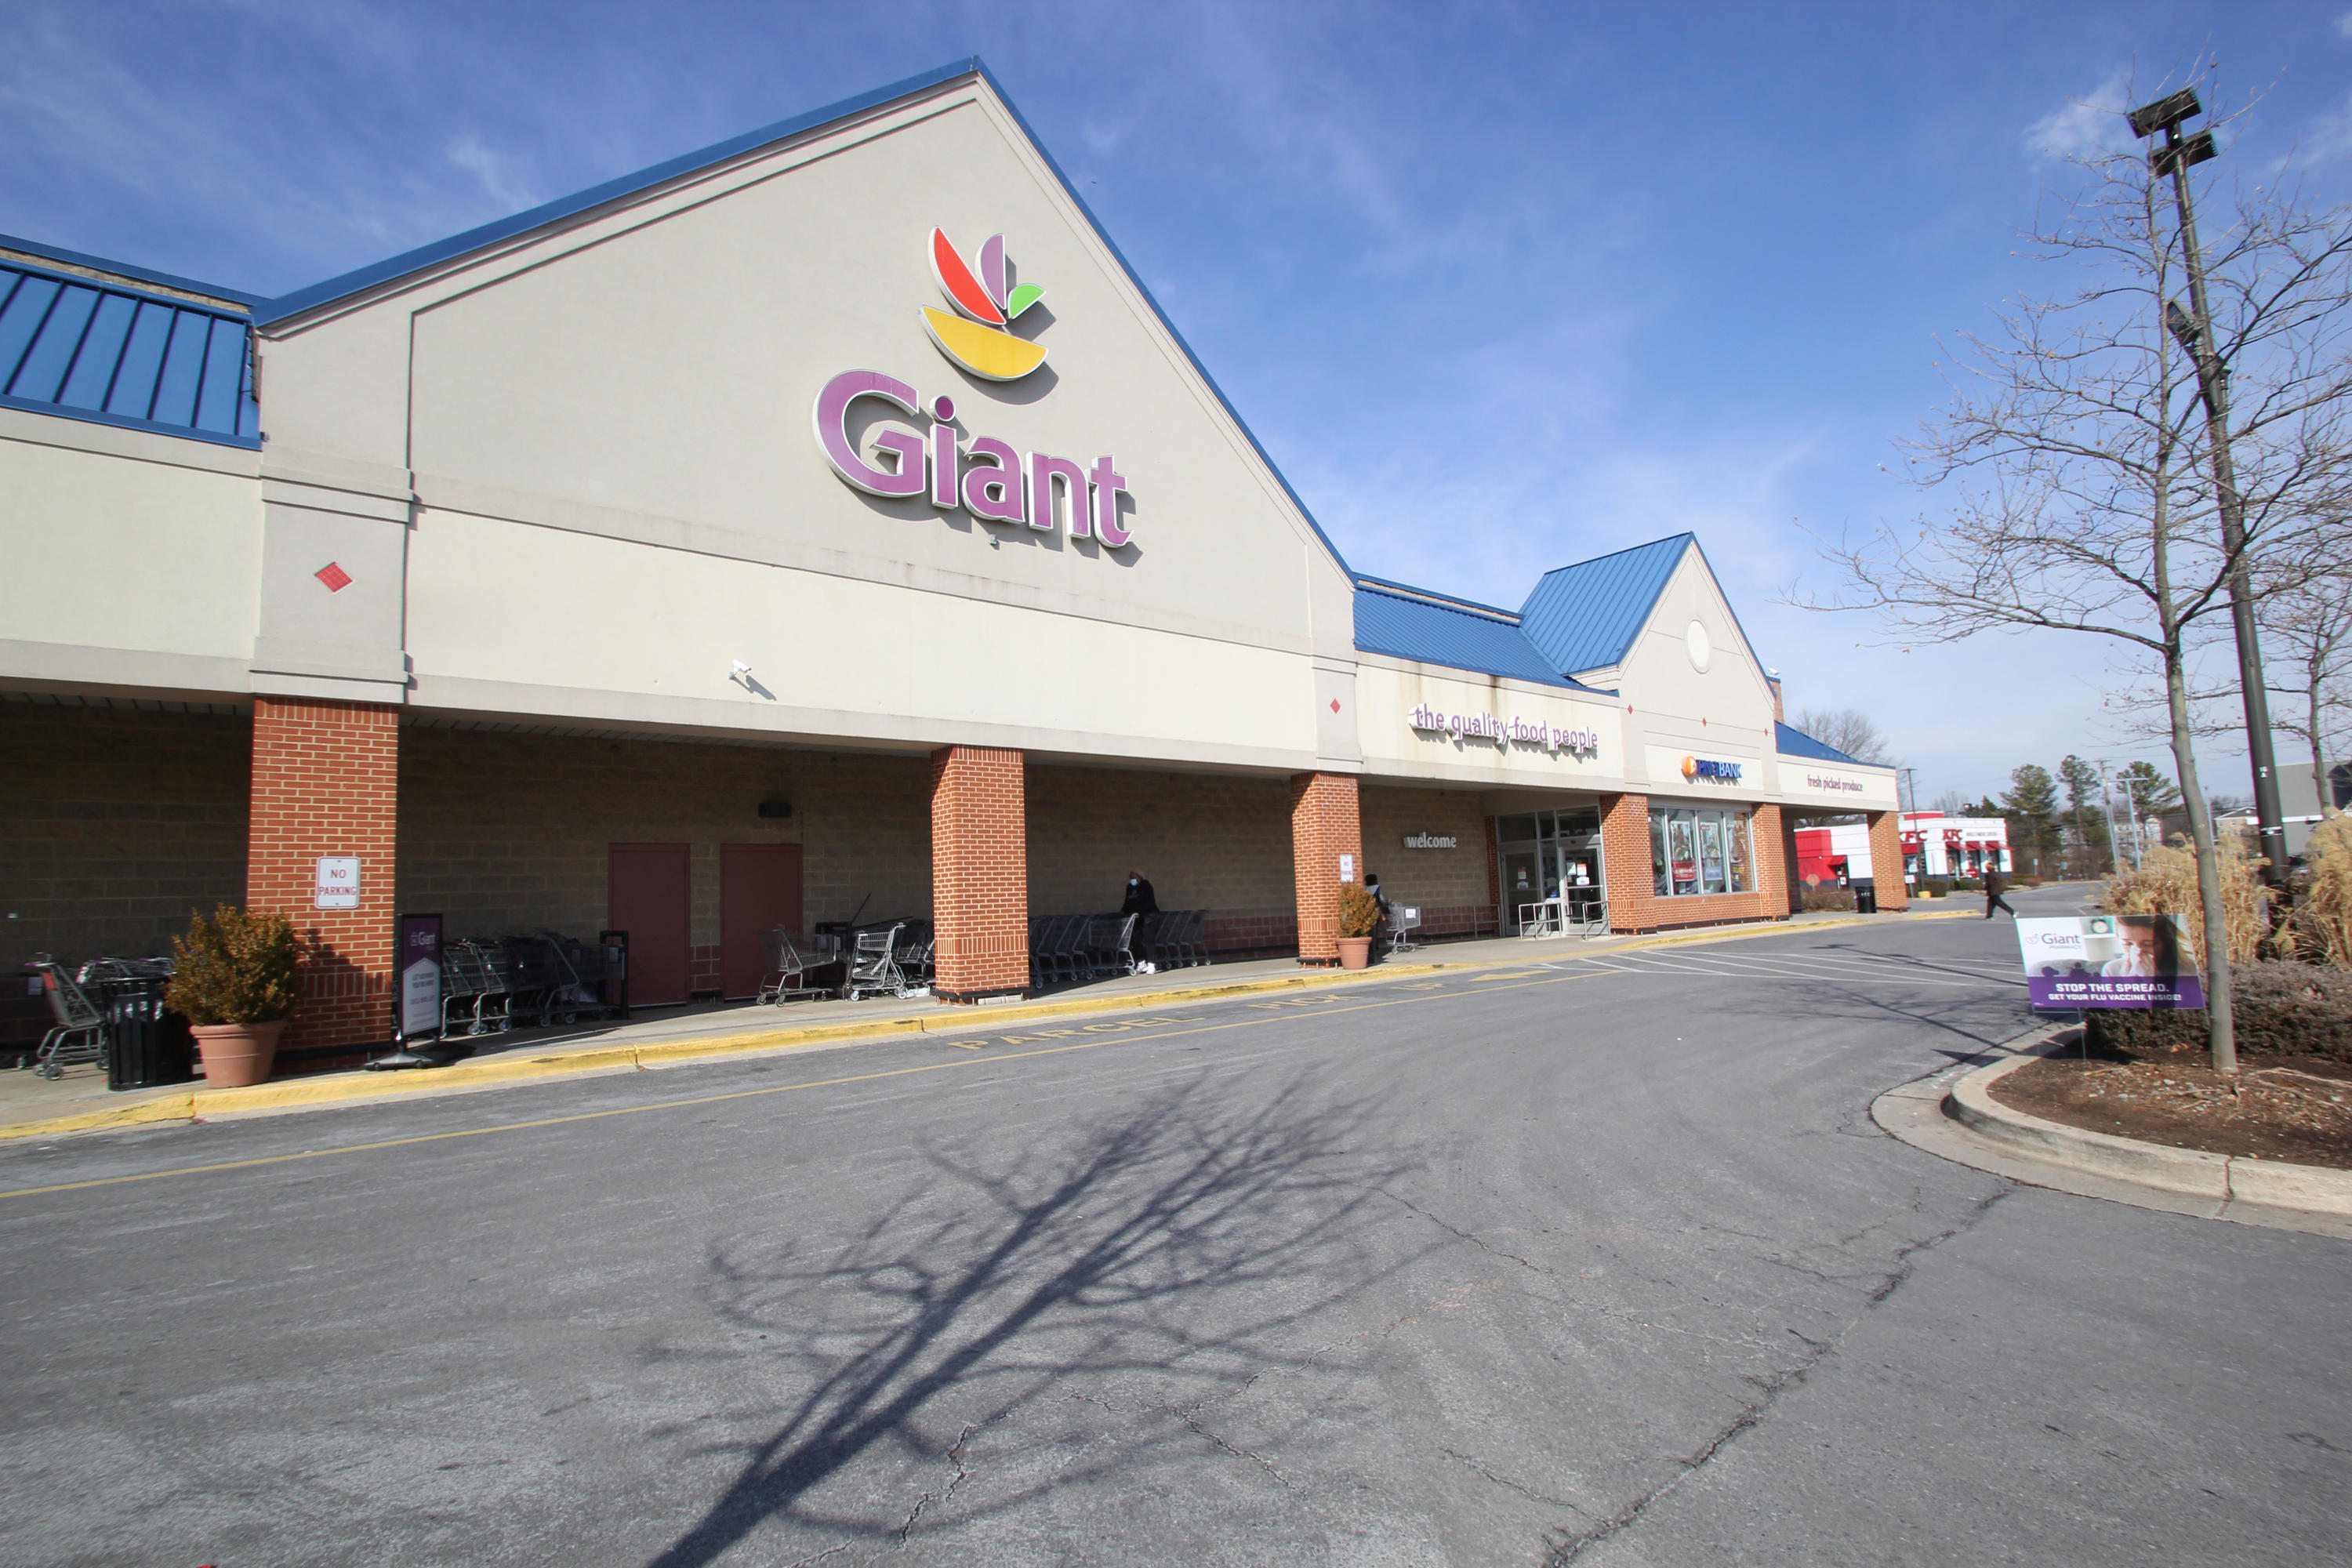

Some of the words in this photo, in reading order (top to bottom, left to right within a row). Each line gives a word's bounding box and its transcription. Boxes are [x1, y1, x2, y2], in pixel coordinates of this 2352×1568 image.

[814, 368, 1134, 548] Giant
[1412, 702, 1446, 731] the
[1450, 711, 1508, 744] quality
[1513, 715, 1548, 743] food
[1552, 725, 1598, 753] people
[1719, 761, 1743, 779] BANK
[1807, 773, 1823, 788] fresh
[1824, 776, 1842, 792] picked
[1842, 779, 1864, 793] produce
[1406, 831, 1457, 848] welcome
[1942, 829, 1962, 840] KFC
[330, 869, 347, 878] NO
[318, 886, 358, 895] PARKING
[2041, 933, 2081, 945] Giant
[2055, 983, 2087, 993] STOP
[2088, 983, 2114, 993] THE
[2115, 983, 2170, 993] SPREAD.
[947, 1017, 1207, 1050] PARCEL
[1247, 994, 1362, 1010] PICK
